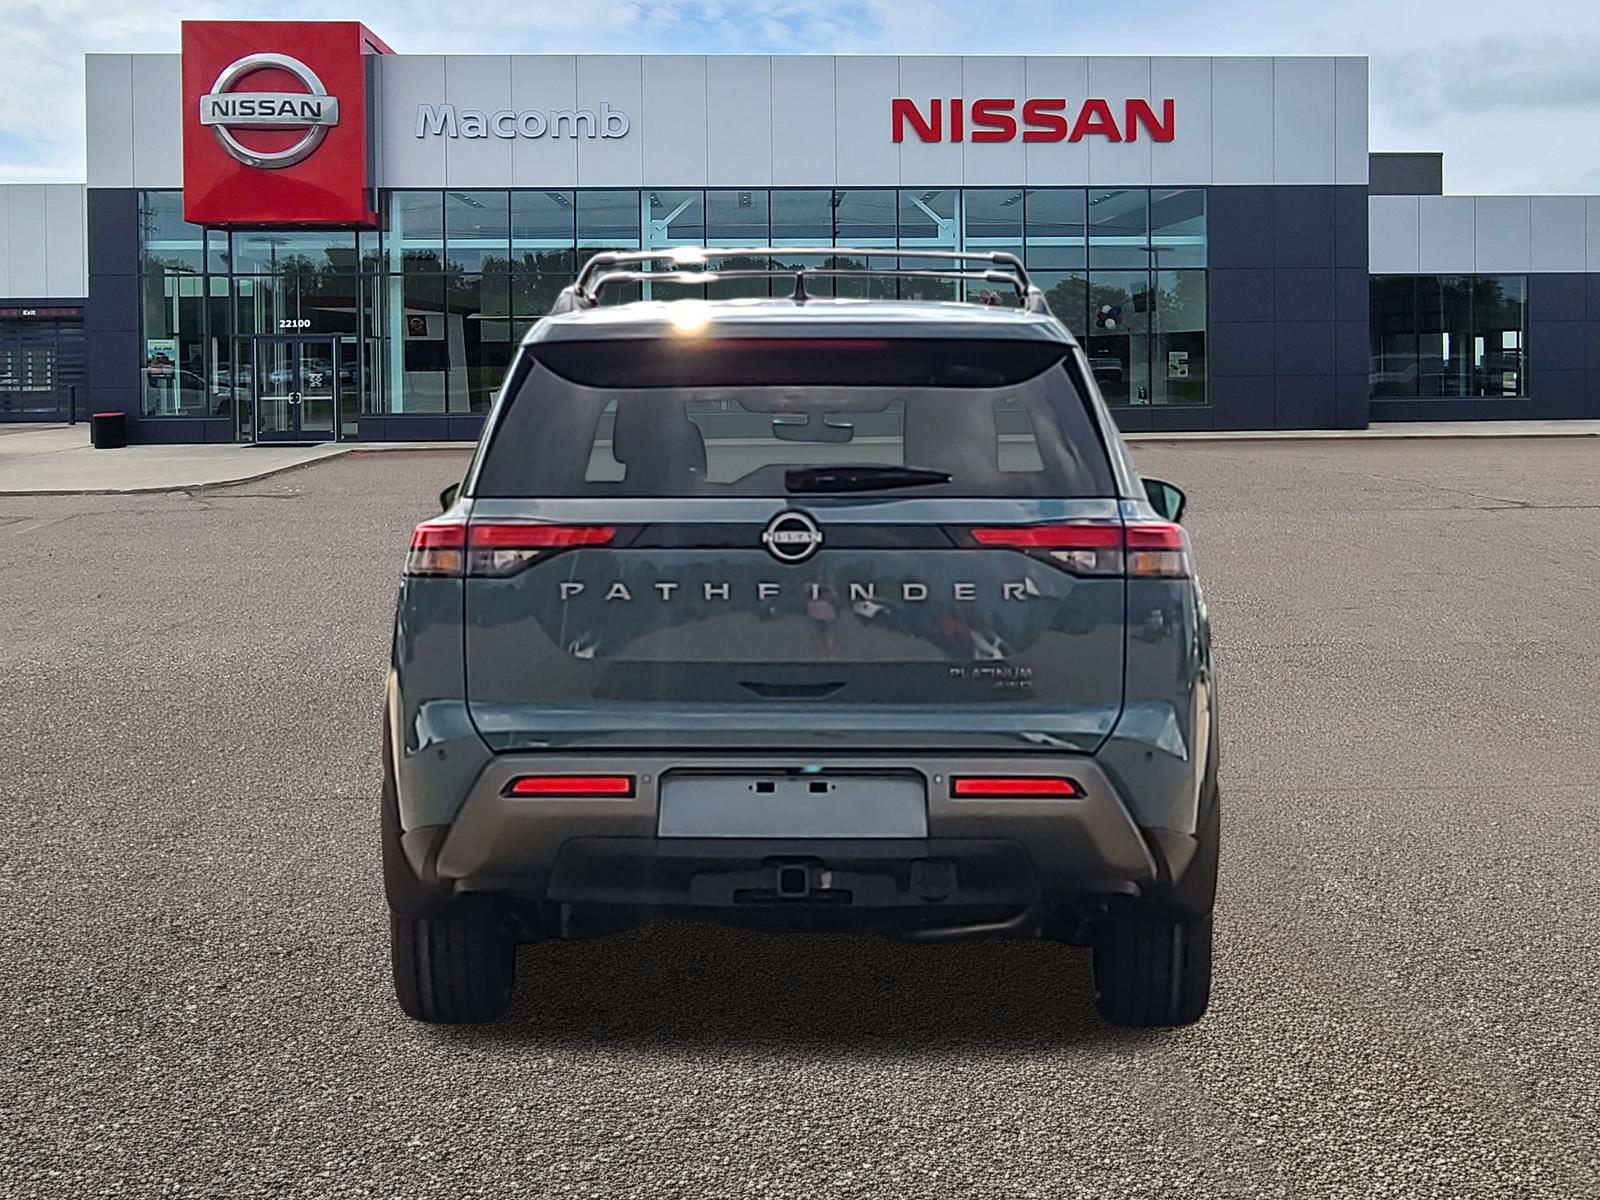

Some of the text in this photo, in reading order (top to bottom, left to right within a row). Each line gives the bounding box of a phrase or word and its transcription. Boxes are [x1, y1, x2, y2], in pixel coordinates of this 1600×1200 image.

[211, 100, 322, 117] NISSAN
[415, 102, 630, 138] Macomb
[891, 98, 1176, 143] NISSAN
[279, 319, 311, 328] 22100
[560, 582, 1026, 600] PATHFINDER
